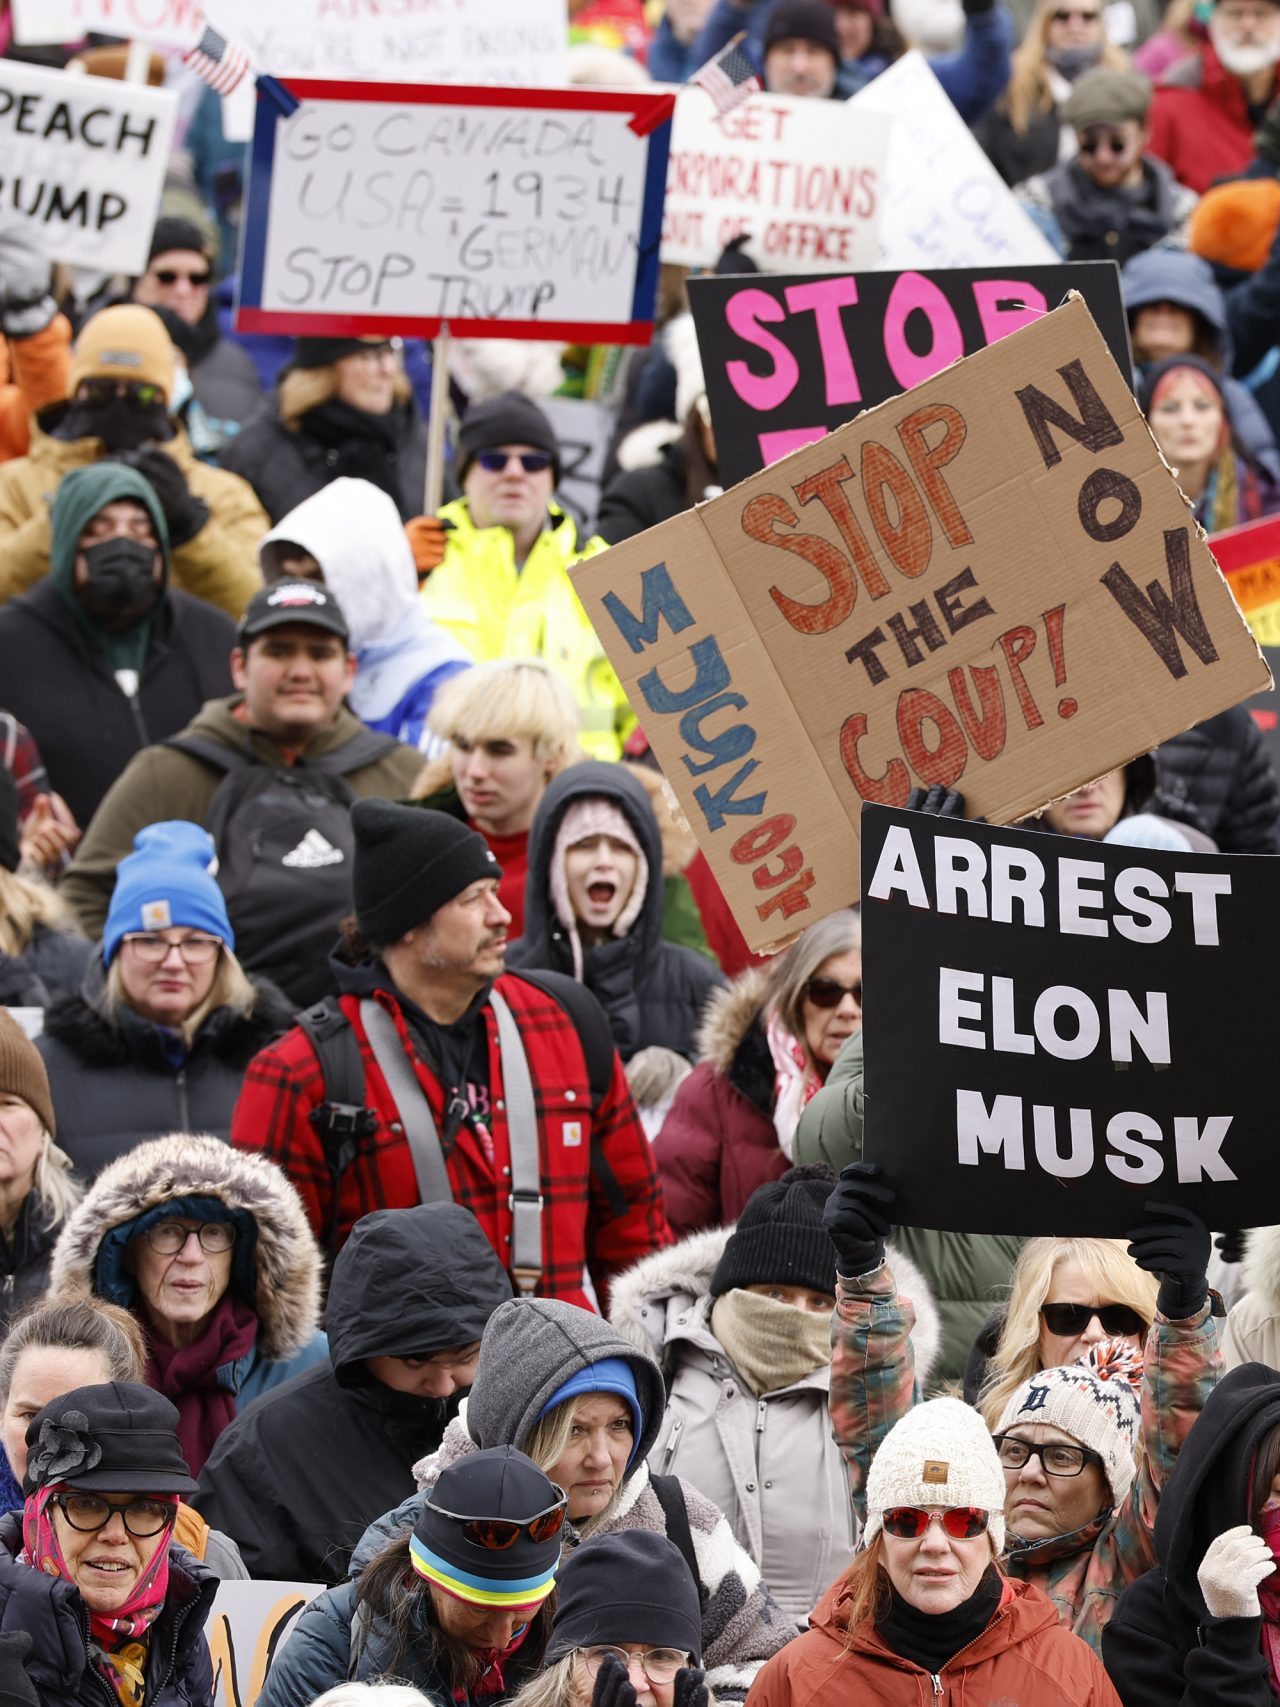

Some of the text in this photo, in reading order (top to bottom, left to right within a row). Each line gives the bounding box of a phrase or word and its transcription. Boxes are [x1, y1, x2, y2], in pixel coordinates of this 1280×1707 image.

[284, 106, 356, 162] GO
[719, 104, 790, 143] GET
[0, 177, 128, 231] UMP
[665, 152, 879, 221] RPORATIONS
[278, 245, 416, 308] STOP
[741, 403, 975, 635] STOP
[845, 566, 999, 687] THE
[601, 561, 769, 833] MUSK
[839, 603, 1079, 806] COUP!
[867, 824, 1232, 947] ARREST
[938, 966, 1172, 1065] ELON
[956, 1088, 1239, 1185] MUSK
